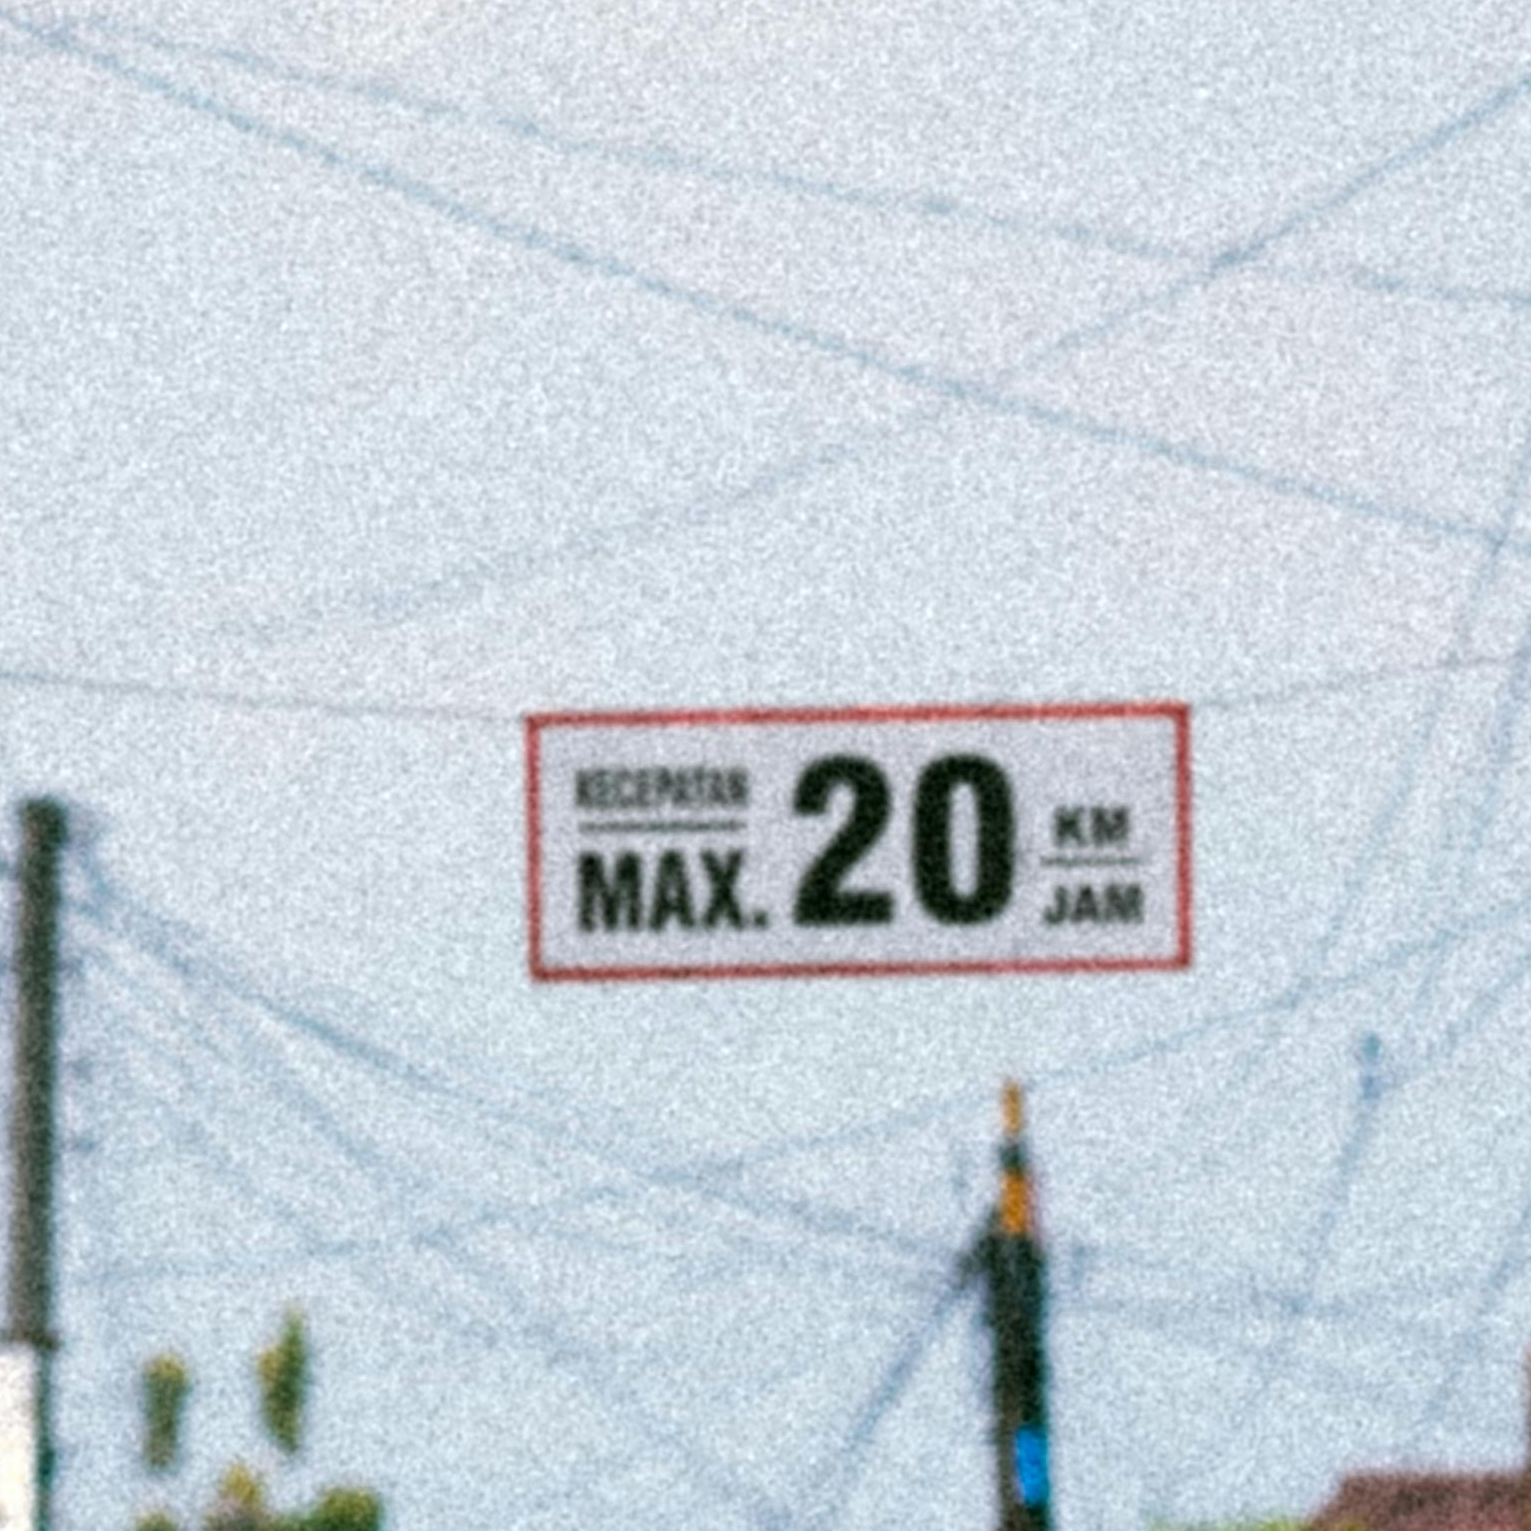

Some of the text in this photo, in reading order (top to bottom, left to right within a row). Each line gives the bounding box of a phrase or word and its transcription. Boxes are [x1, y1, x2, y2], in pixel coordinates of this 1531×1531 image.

[575, 767, 748, 809] KECEPATAN
[578, 754, 1016, 932] MAX. 20
[1052, 805, 1131, 848] KM
[1044, 884, 1144, 925] JAM
